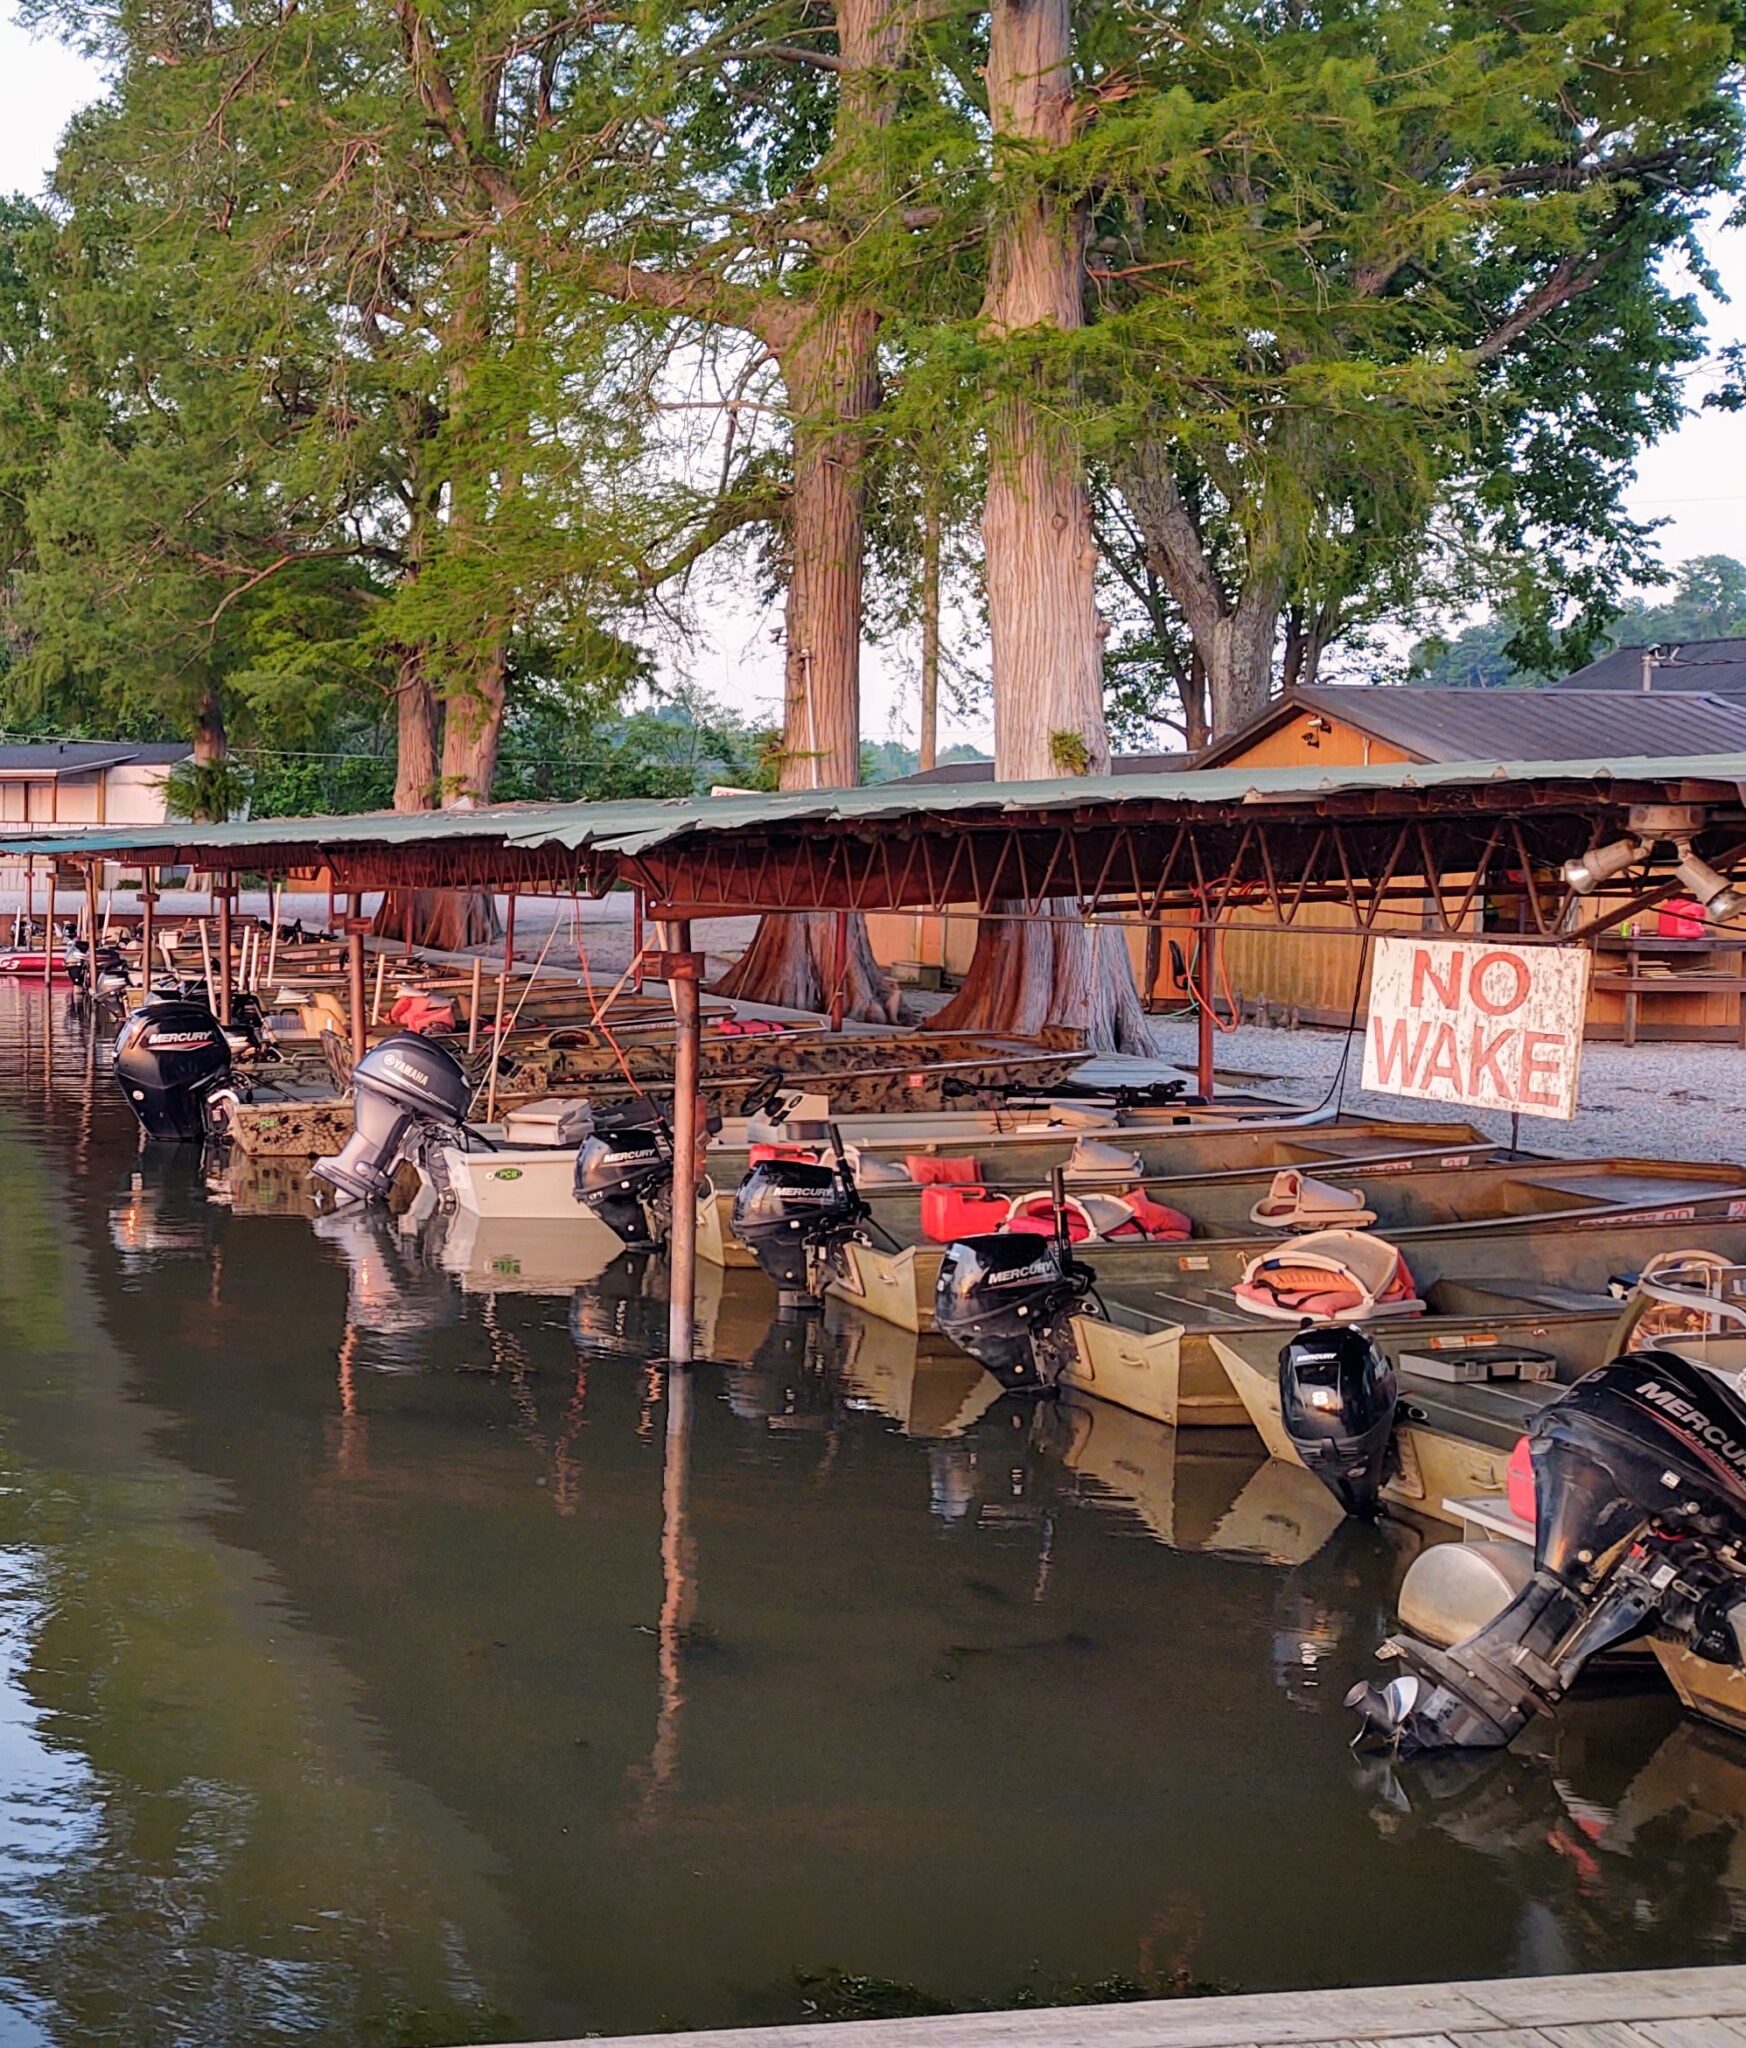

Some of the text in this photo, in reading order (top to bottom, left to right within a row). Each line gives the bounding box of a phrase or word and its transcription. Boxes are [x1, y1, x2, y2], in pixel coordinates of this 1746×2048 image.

[1410, 949, 1531, 1016] NO
[149, 1031, 212, 1044] MERCURY
[1373, 1016, 1565, 1107] WAKE
[393, 1059, 429, 1086] YAMAHA
[603, 1149, 656, 1163] MERCURY
[500, 1171, 518, 1179] PCB
[773, 1187, 834, 1197] MERCURY
[988, 1261, 1053, 1285] MERCURY
[1297, 1353, 1337, 1362] MERCURY
[1312, 1391, 1329, 1406] 8
